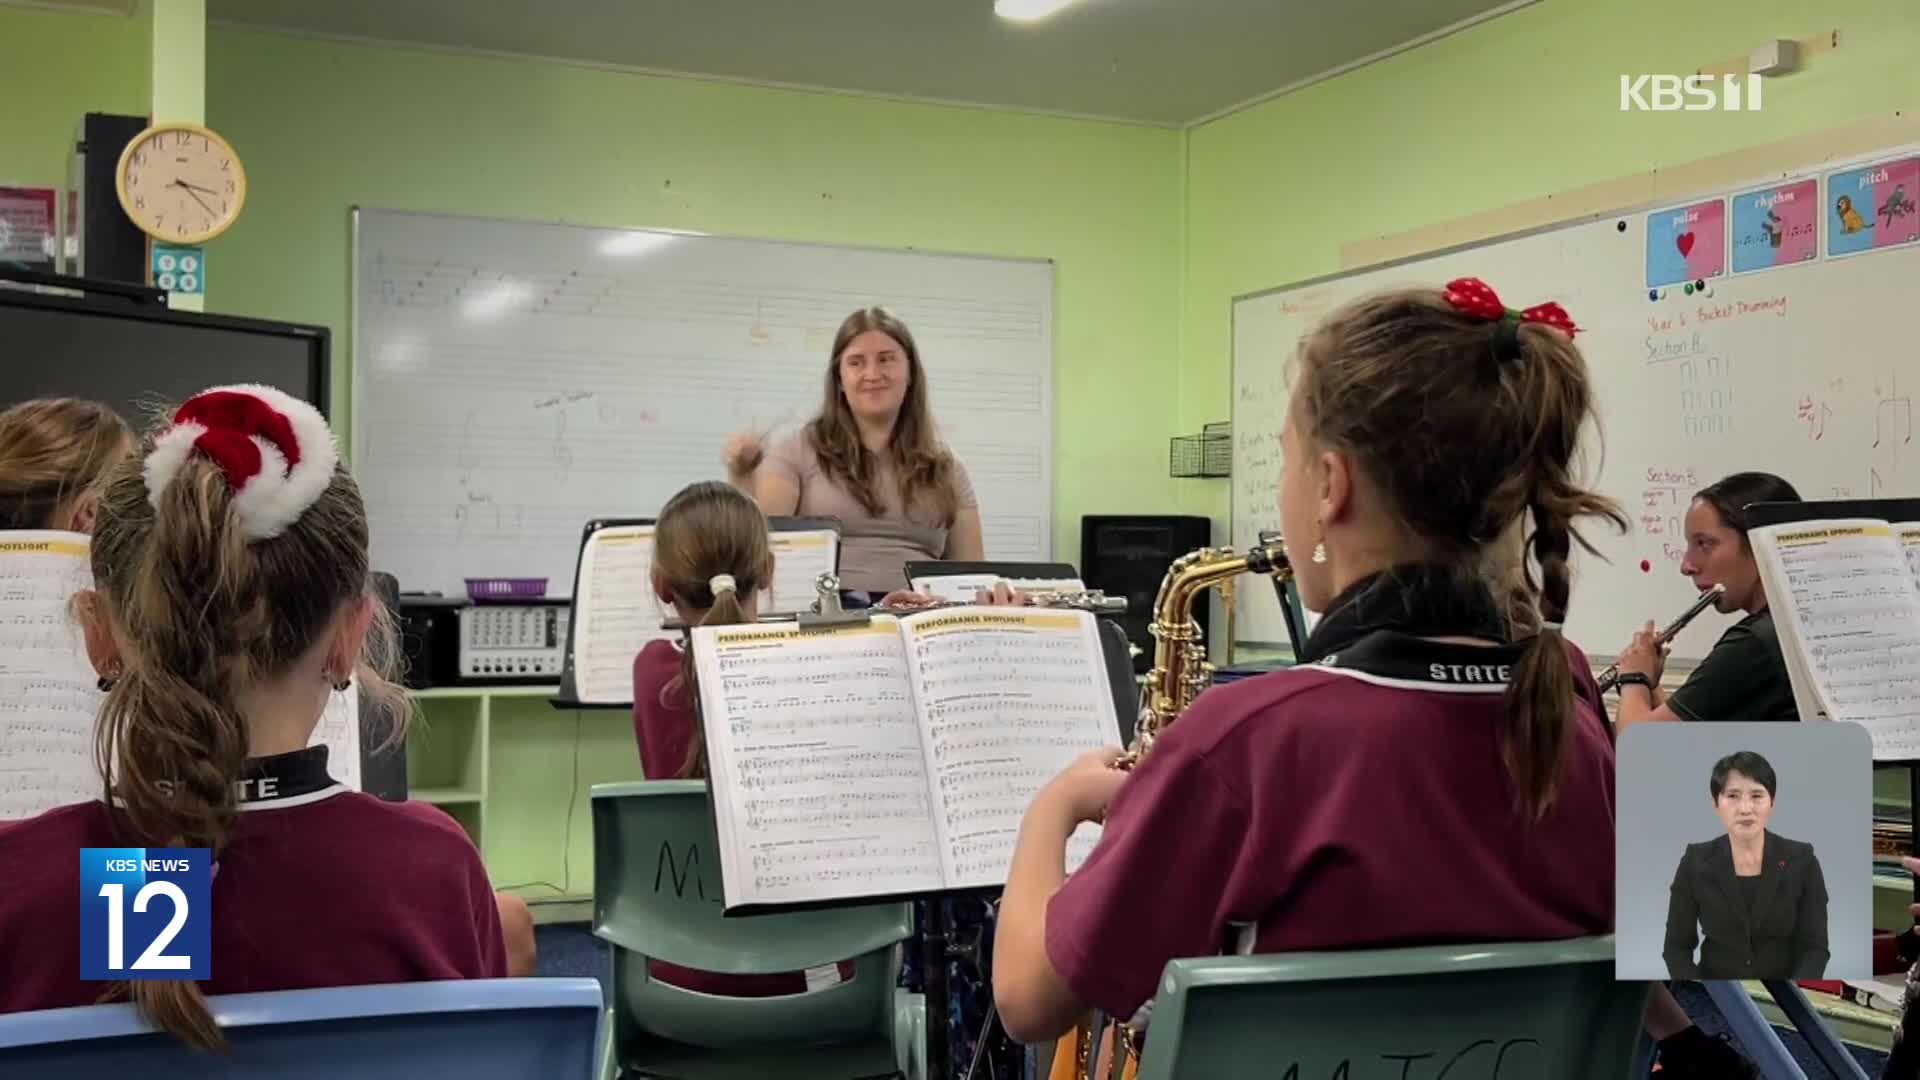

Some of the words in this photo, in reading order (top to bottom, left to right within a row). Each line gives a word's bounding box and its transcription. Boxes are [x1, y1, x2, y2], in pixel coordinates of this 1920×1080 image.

[175, 131, 191, 145] 12
[1859, 170, 1889, 190] pitch
[916, 615, 980, 631] PERFORMANCE
[983, 614, 1025, 624] SPOTLIGHT
[718, 631, 785, 642] PERFORMANCE
[1429, 663, 1512, 682] STATE
[153, 776, 280, 799] STE
